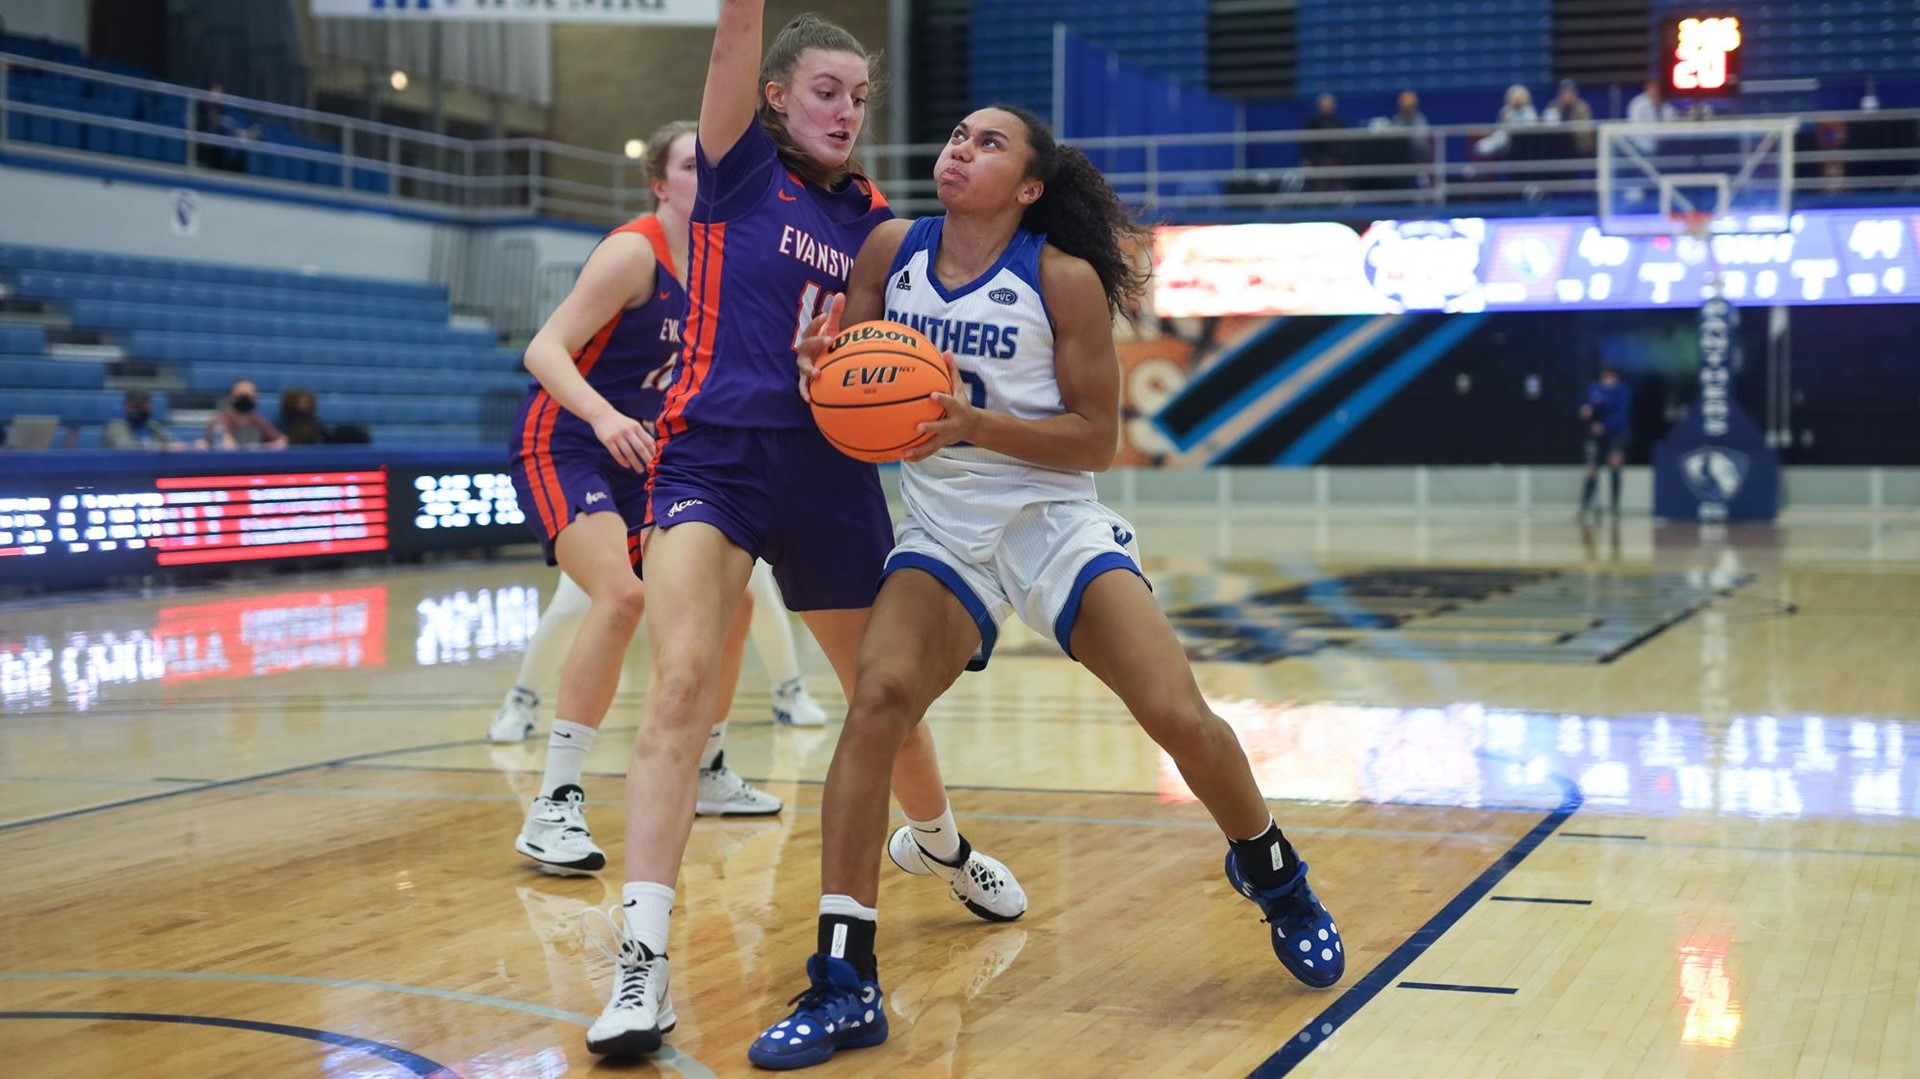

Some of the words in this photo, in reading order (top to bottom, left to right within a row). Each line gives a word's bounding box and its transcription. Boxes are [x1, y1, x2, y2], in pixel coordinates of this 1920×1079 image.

[779, 224, 854, 282] EVANSV
[828, 326, 919, 354] Wilson
[842, 365, 899, 388] EVO
[667, 498, 704, 518] Aces
